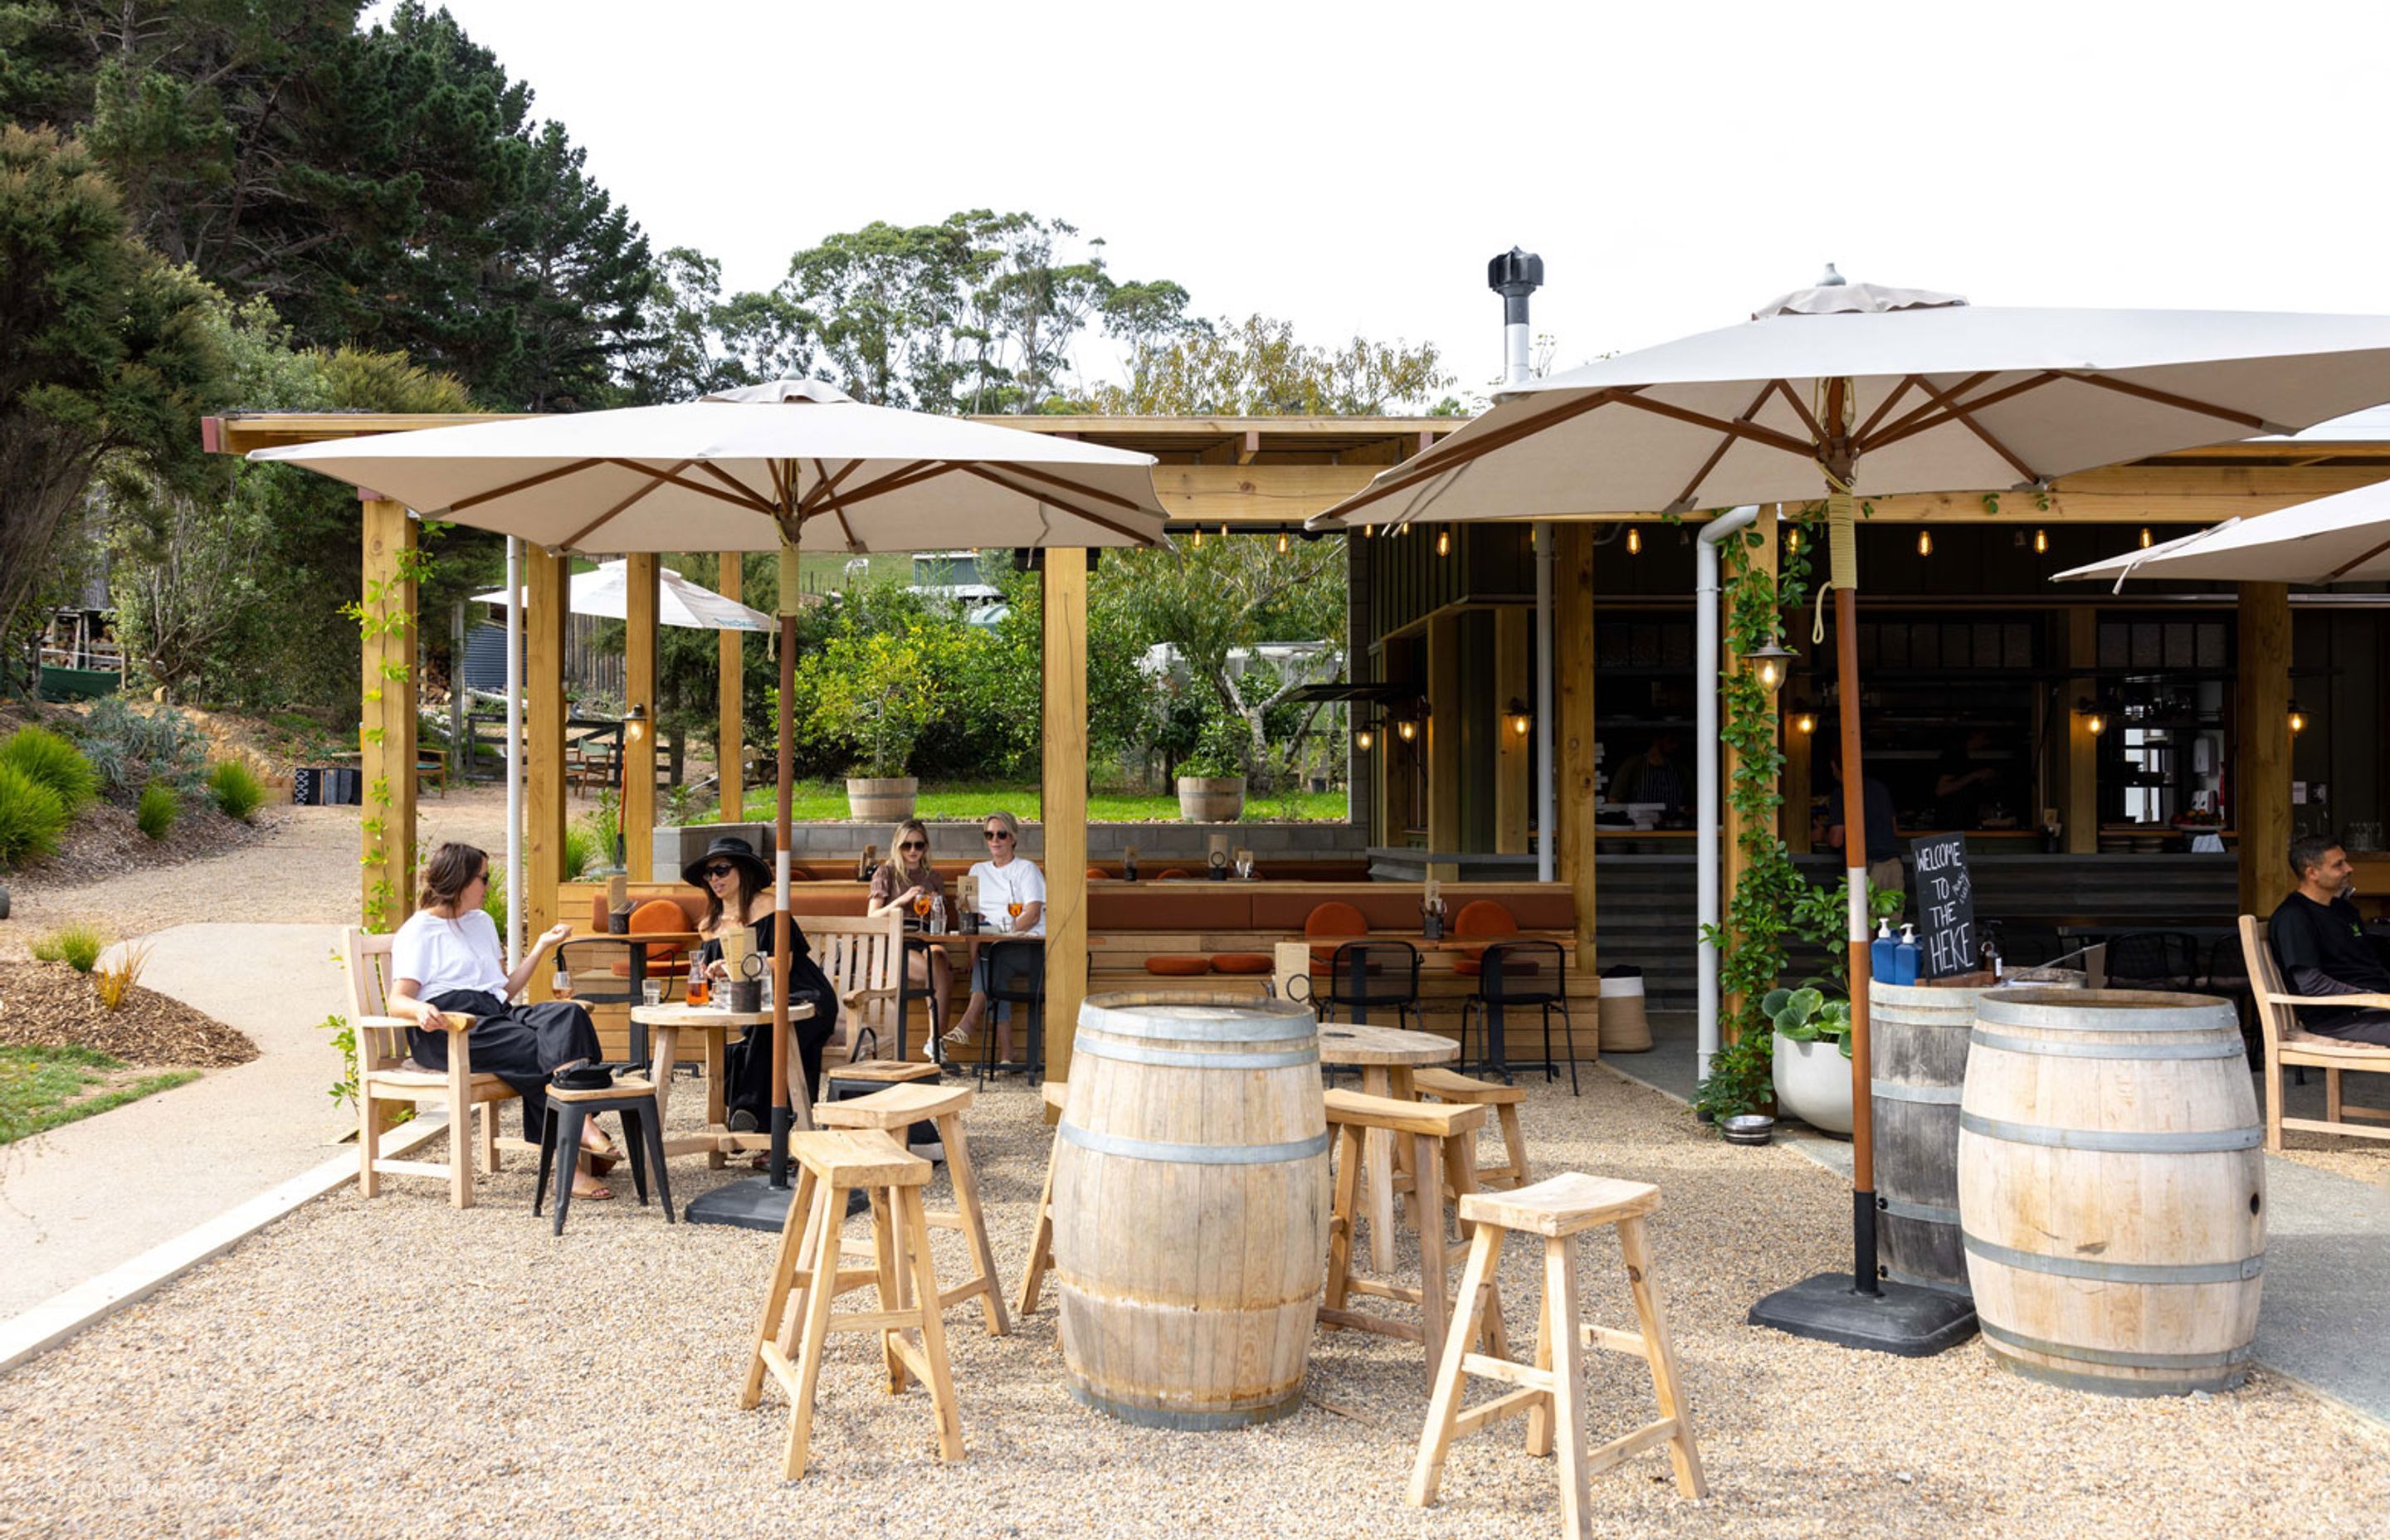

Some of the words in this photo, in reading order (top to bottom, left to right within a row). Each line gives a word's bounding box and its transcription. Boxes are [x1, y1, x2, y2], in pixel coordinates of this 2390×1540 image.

[1915, 841, 1963, 872] WELCOME
[1930, 877, 1950, 901] TO
[1929, 901, 1958, 928] THE
[1929, 922, 1974, 975] HEKE
